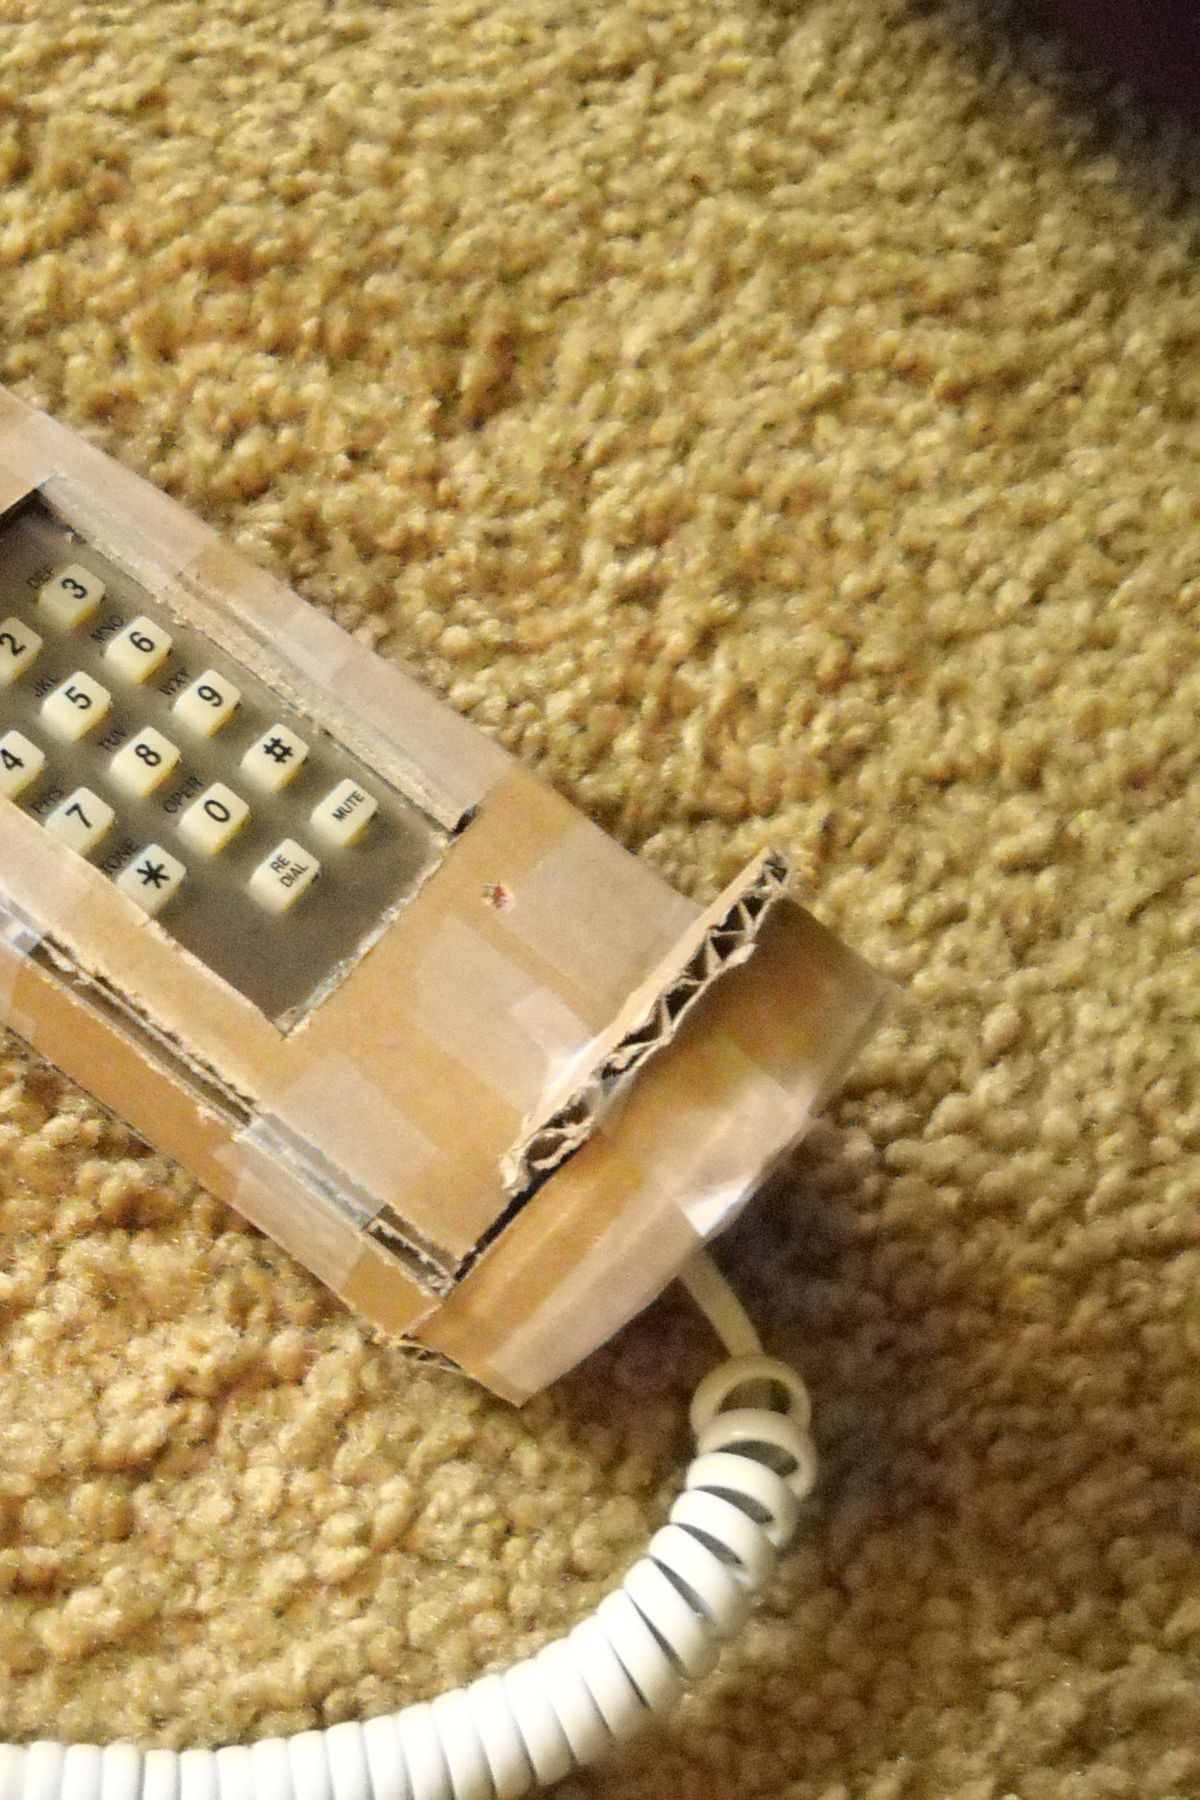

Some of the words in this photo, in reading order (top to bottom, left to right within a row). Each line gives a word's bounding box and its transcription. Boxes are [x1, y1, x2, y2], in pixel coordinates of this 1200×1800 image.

[61, 577, 88, 600] 3
[129, 631, 155, 653] 6
[65, 685, 93, 710] 5
[197, 685, 223, 708] 9
[0, 747, 25, 771] 4
[135, 743, 162, 767] 8
[65, 803, 92, 829] 7
[205, 799, 232, 824] 0
[331, 790, 365, 822] MUTE
[270, 854, 291, 873] RE
[280, 863, 309, 888] DIAL
